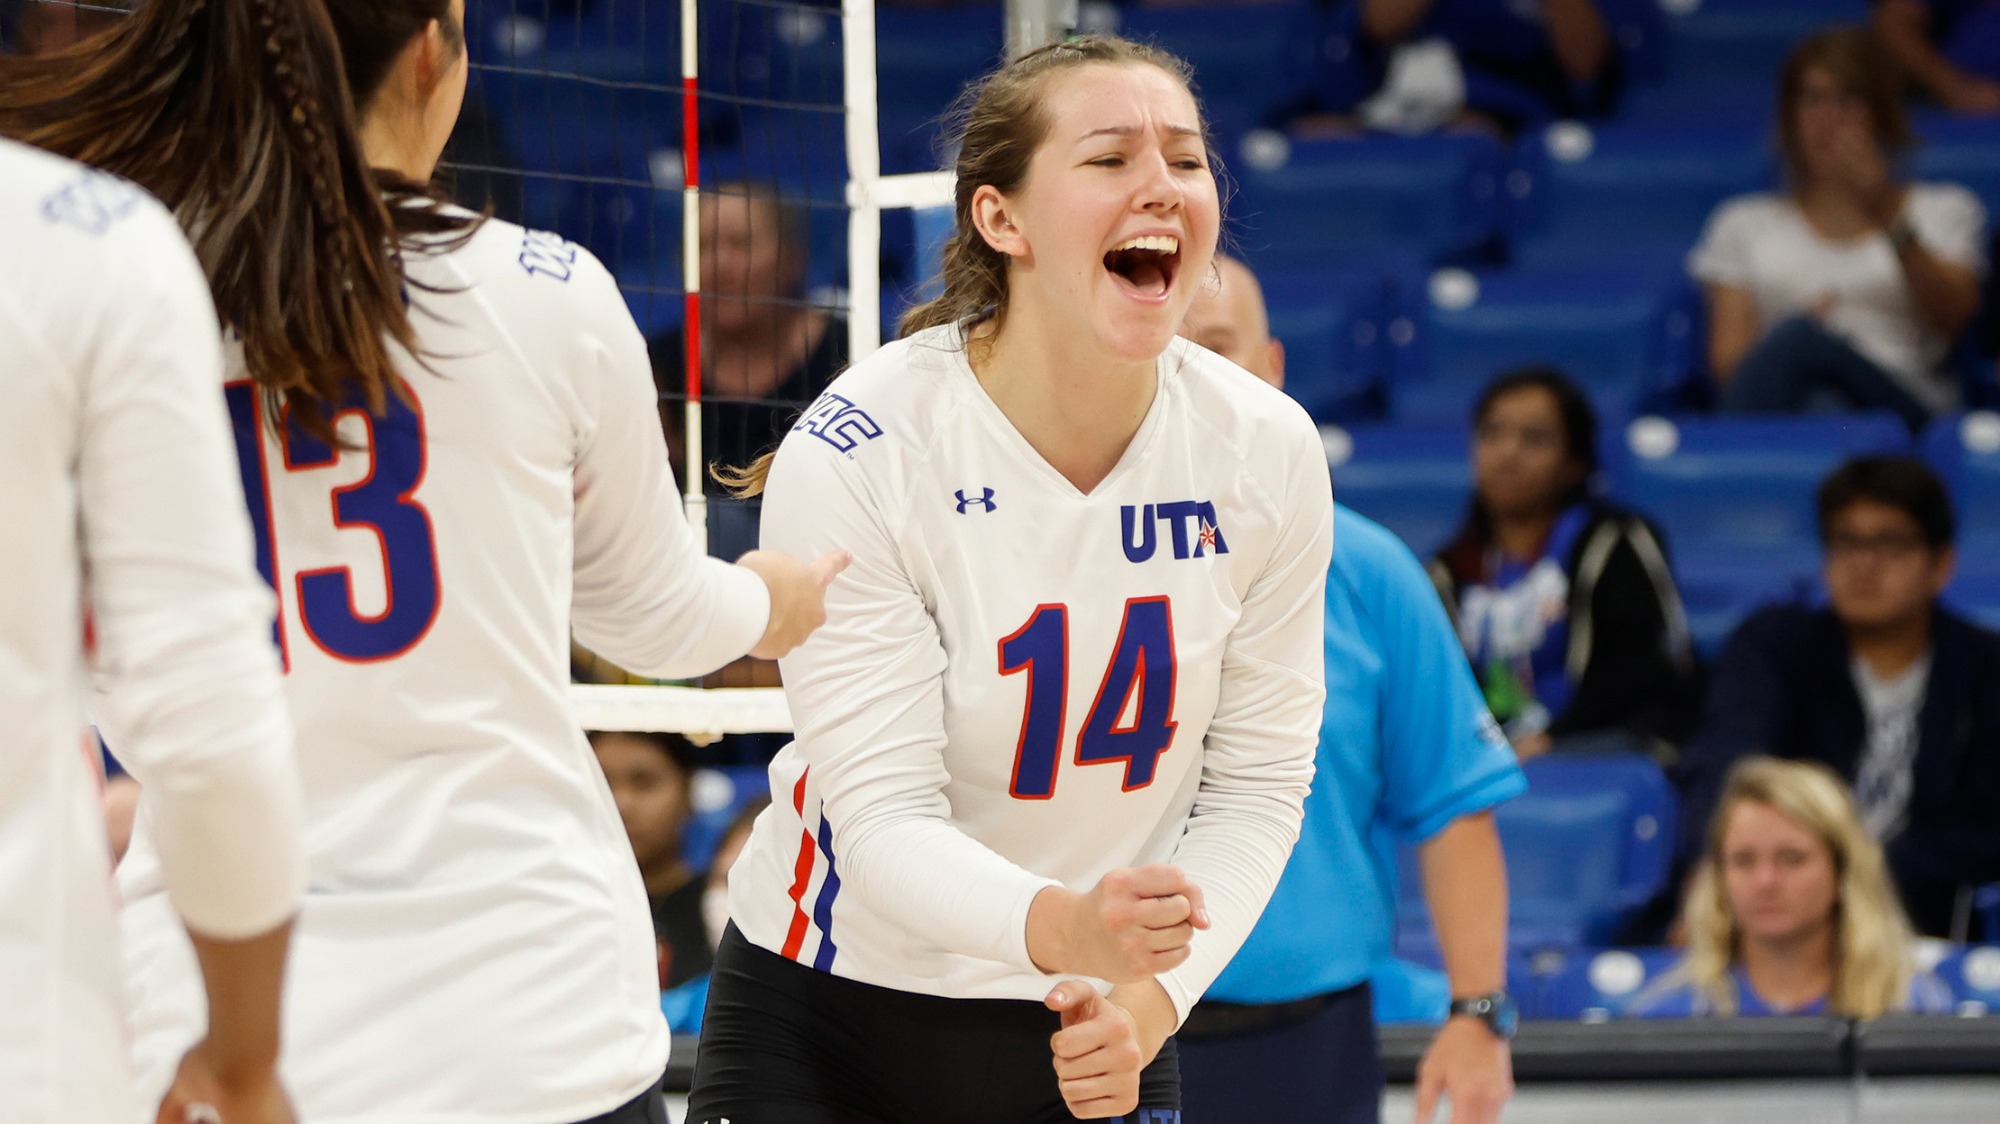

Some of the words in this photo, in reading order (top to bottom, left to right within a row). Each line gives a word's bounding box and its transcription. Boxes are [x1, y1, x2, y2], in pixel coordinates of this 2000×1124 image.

[793, 392, 884, 453] AC
[1120, 500, 1230, 563] UTA
[997, 594, 1179, 800] 14
